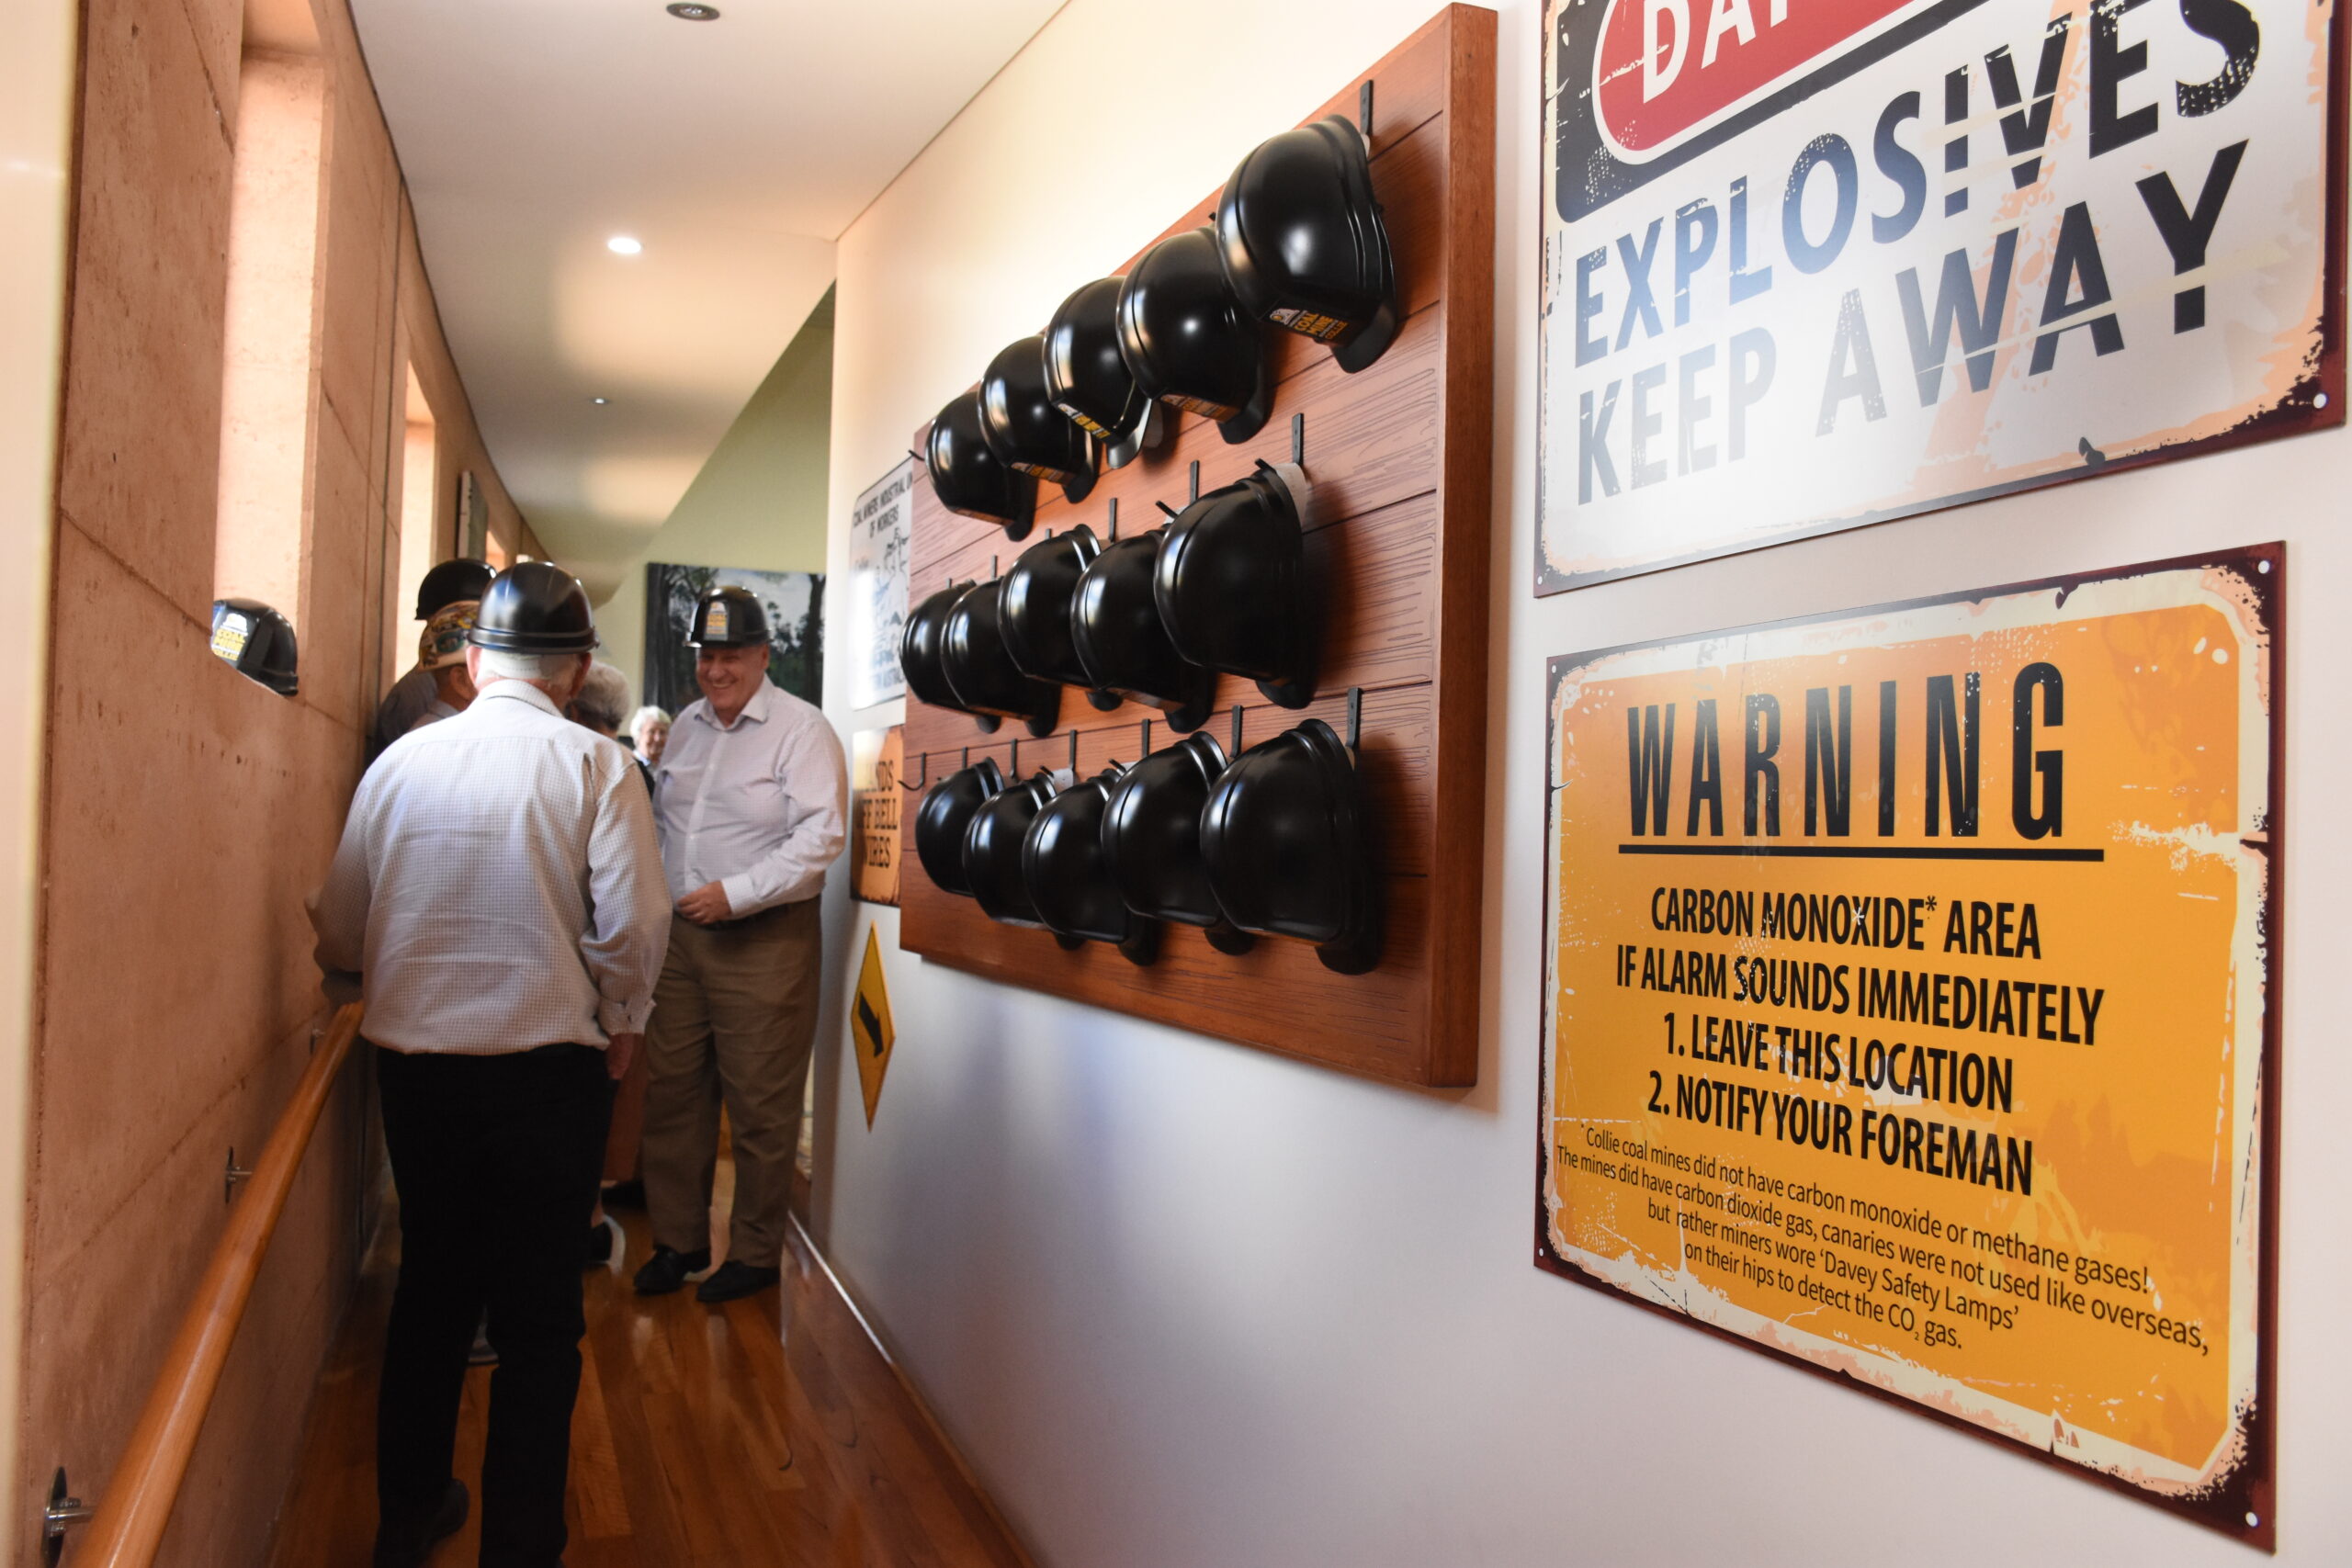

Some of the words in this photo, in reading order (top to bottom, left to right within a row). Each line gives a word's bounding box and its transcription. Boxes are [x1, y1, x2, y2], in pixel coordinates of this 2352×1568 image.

[1576, 0, 2260, 367] EXPLOSIVES
[1578, 327, 1776, 505] KEEP
[1815, 139, 2249, 437] AWAY
[1627, 661, 2064, 840] WARNING
[875, 797, 897, 830] BELL
[1652, 886, 1753, 938] CARBON
[1943, 900, 2041, 959] AREA
[1617, 944, 1636, 987] IF
[1641, 947, 1726, 999] ALARM
[1733, 955, 1849, 1014] SOUNDS
[1858, 966, 2104, 1045] IMMEDIATELY
[1664, 1012, 1685, 1056] 1.
[1691, 1014, 1768, 1071] LEAVE
[1775, 1026, 1839, 1082] THIS
[1849, 1036, 2012, 1113] LOCATION
[1648, 1070, 1669, 1115] 2.
[1677, 1074, 1768, 1135] NOTIFY
[1772, 1092, 1852, 1156] YOUR
[1860, 1109, 2032, 1196] FOREMAN
[1557, 1145, 1577, 1168] The
[1580, 1155, 1616, 1179] mines
[1619, 1163, 1638, 1186] did
[1642, 1166, 1673, 1195] have
[1675, 1183, 1724, 1211] carbon
[1727, 1192, 1782, 1226] dioxide
[1786, 1213, 1817, 1241] gas,
[1822, 1223, 1894, 1259] canaries
[1899, 1244, 1945, 1274] were
[1951, 1258, 1984, 1285] not
[1989, 1269, 2040, 1301] used
[2047, 1278, 2085, 1314] like
[2091, 1298, 2208, 1356] overseas,
[1622, 1141, 1647, 1160] coal
[1651, 1147, 1690, 1172] mines
[1693, 1155, 1716, 1179] did
[1720, 1165, 1744, 1186] not
[1747, 1167, 1783, 1197] have
[1787, 1182, 1845, 1213] carbon
[1850, 1198, 1942, 1238] monoxide
[1947, 1224, 1968, 1244] or
[1973, 1229, 2069, 1272] methane
[2075, 1257, 2148, 1294] gases!
[1647, 1198, 1671, 1224] but
[1676, 1211, 1718, 1236] rather
[1721, 1224, 1772, 1255] miners
[1775, 1240, 1815, 1268] wore
[1882, 1269, 1940, 1312] Safety
[1685, 1243, 1702, 1261] on
[1705, 1244, 1740, 1275] their
[1743, 1254, 1775, 1287] hips
[1777, 1269, 1794, 1292] to
[1798, 1275, 1850, 1313] detect
[1855, 1292, 1883, 1323] the
[1924, 1320, 1962, 1349] gas.
